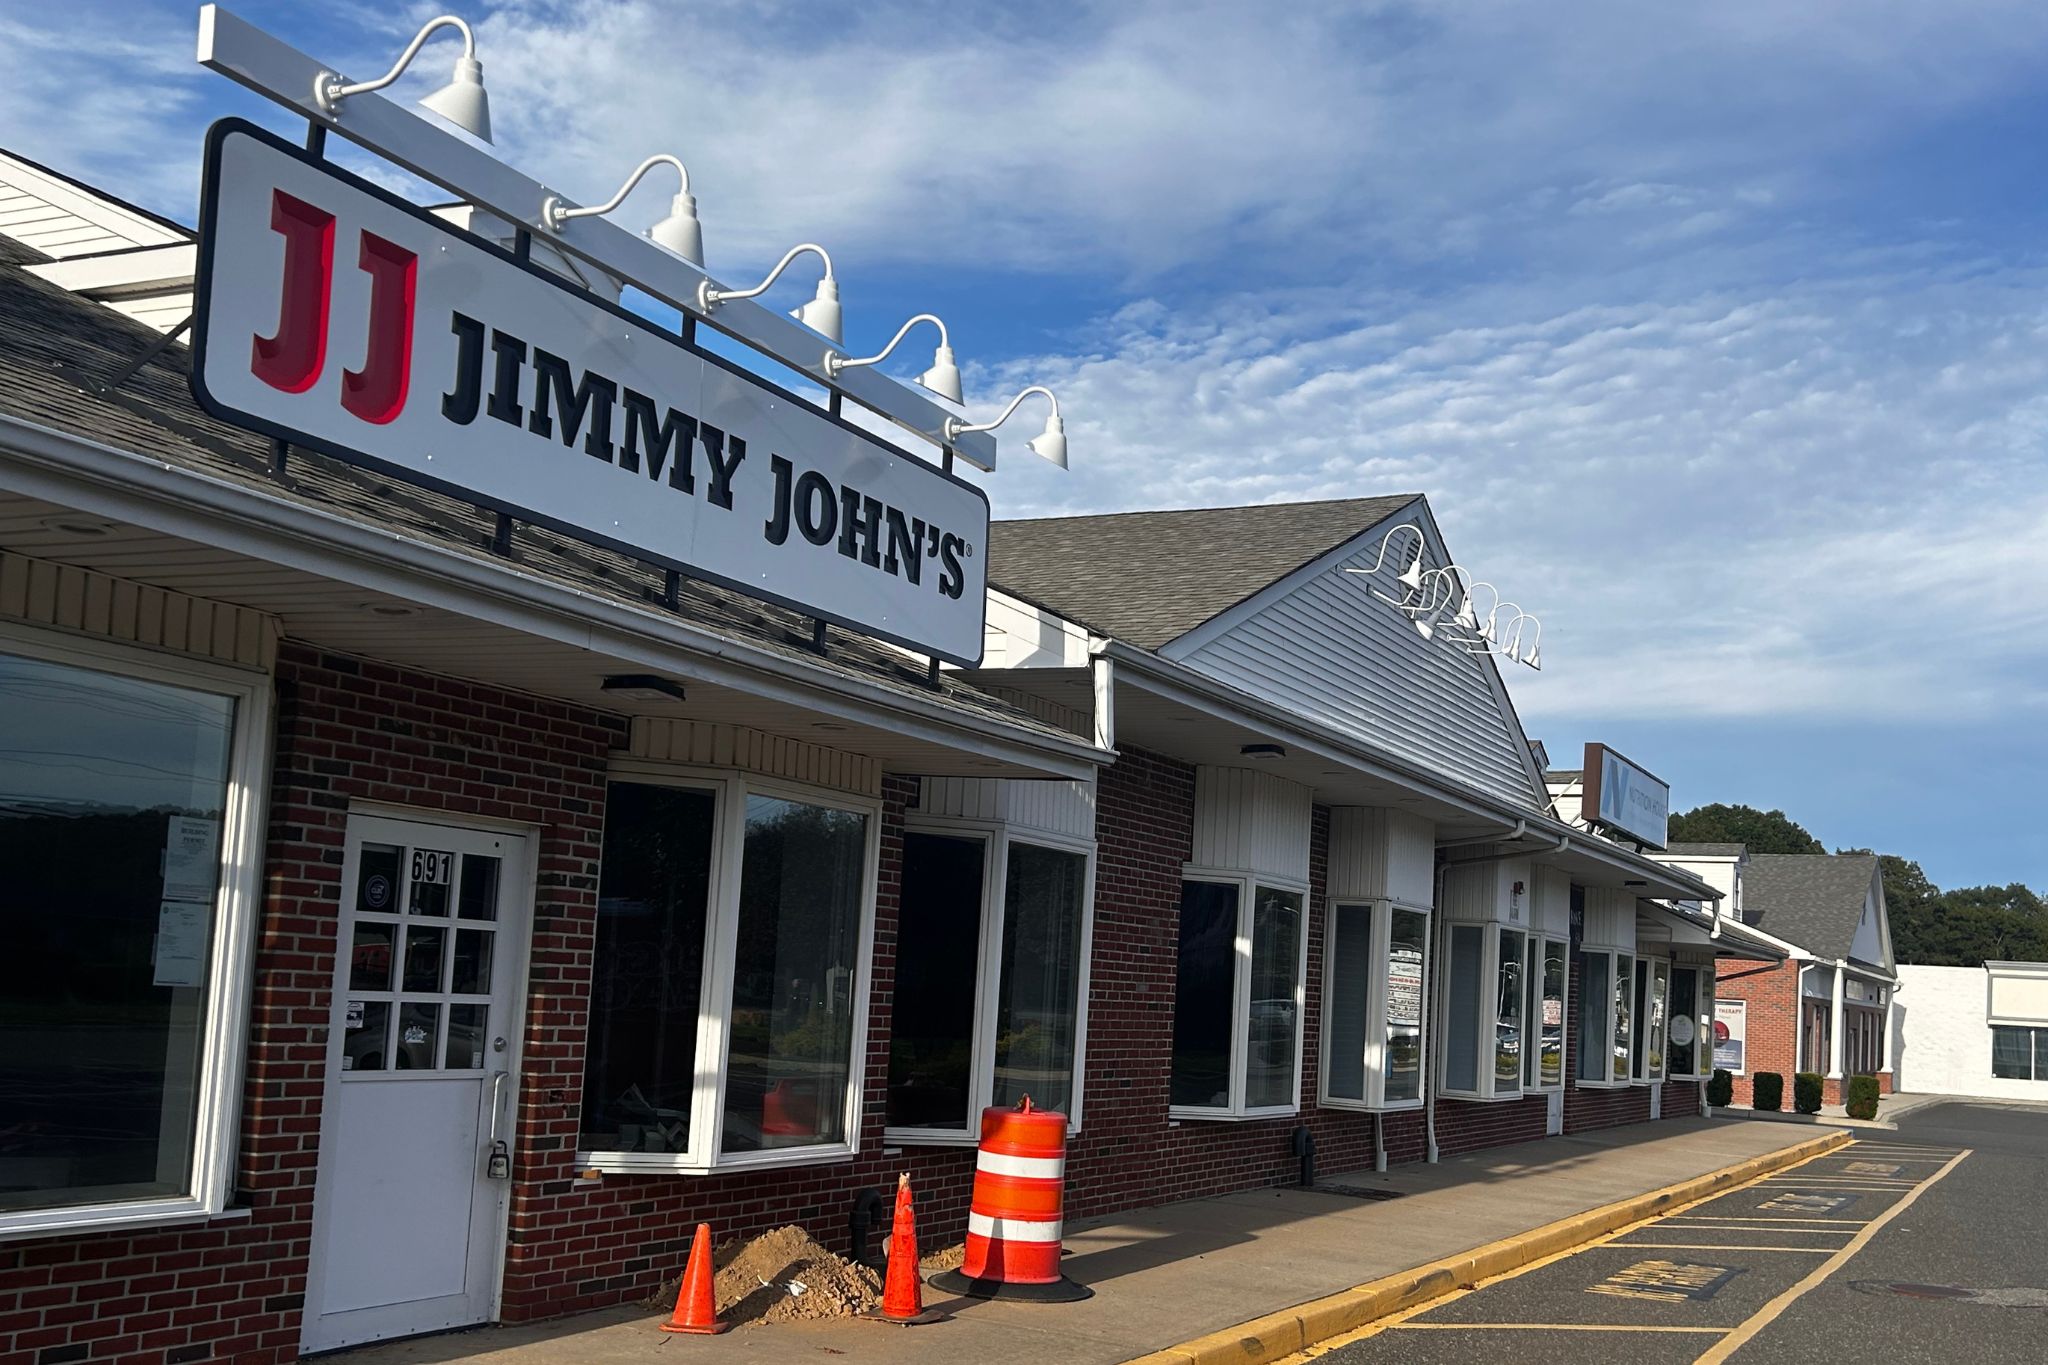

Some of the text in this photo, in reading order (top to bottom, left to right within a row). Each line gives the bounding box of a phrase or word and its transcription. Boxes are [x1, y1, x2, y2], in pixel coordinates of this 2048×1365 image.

[251, 188, 418, 425] JJ
[442, 310, 746, 511] JIMMY
[412, 851, 450, 883] 691
